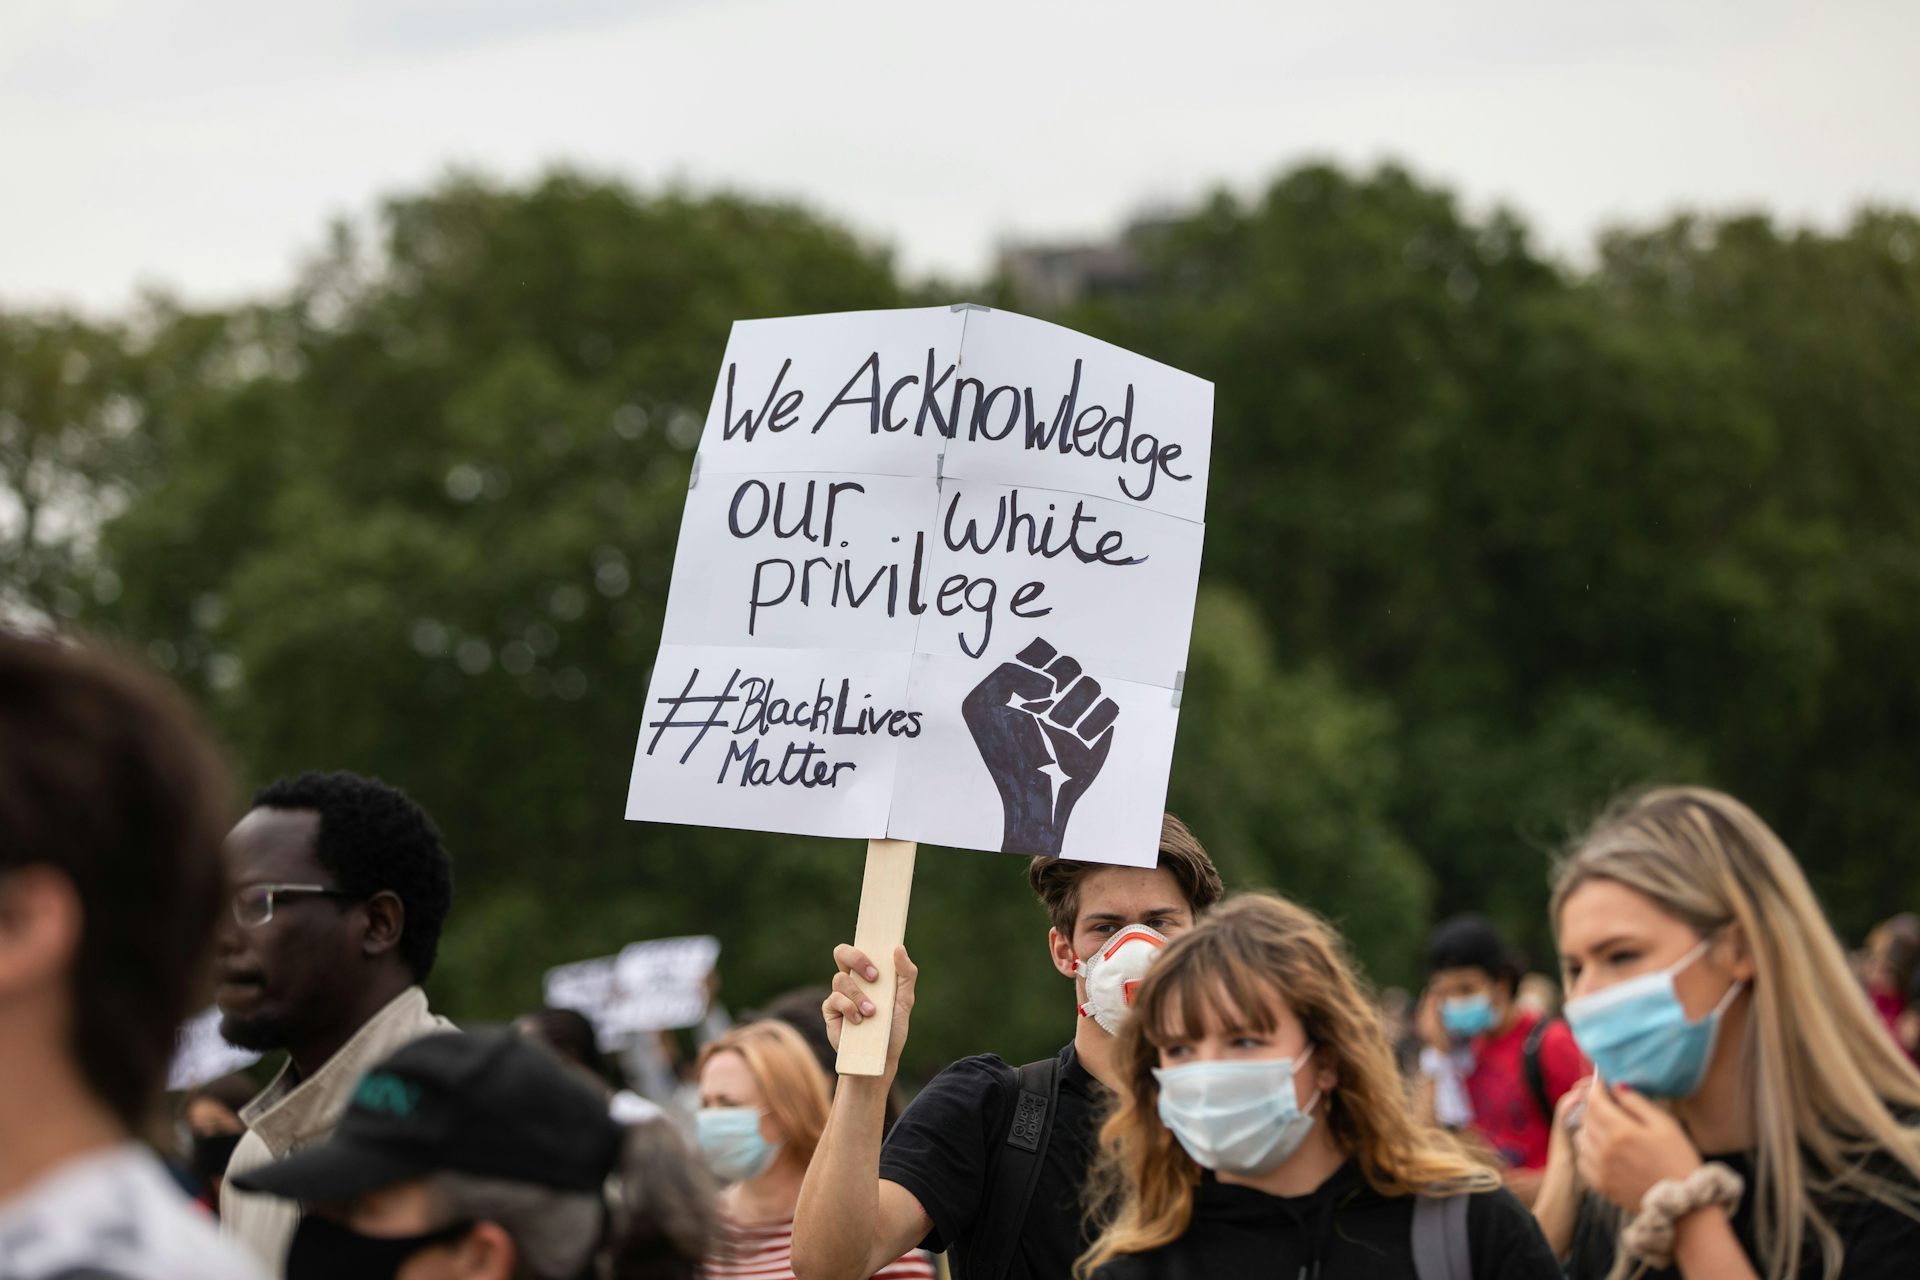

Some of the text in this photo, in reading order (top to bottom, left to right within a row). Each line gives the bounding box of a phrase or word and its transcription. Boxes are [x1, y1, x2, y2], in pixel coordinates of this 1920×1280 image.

[723, 347, 1193, 502] We Acknowledge
[728, 479, 865, 548] our
[748, 530, 1053, 660] privilege
[717, 738, 857, 789] Matter
